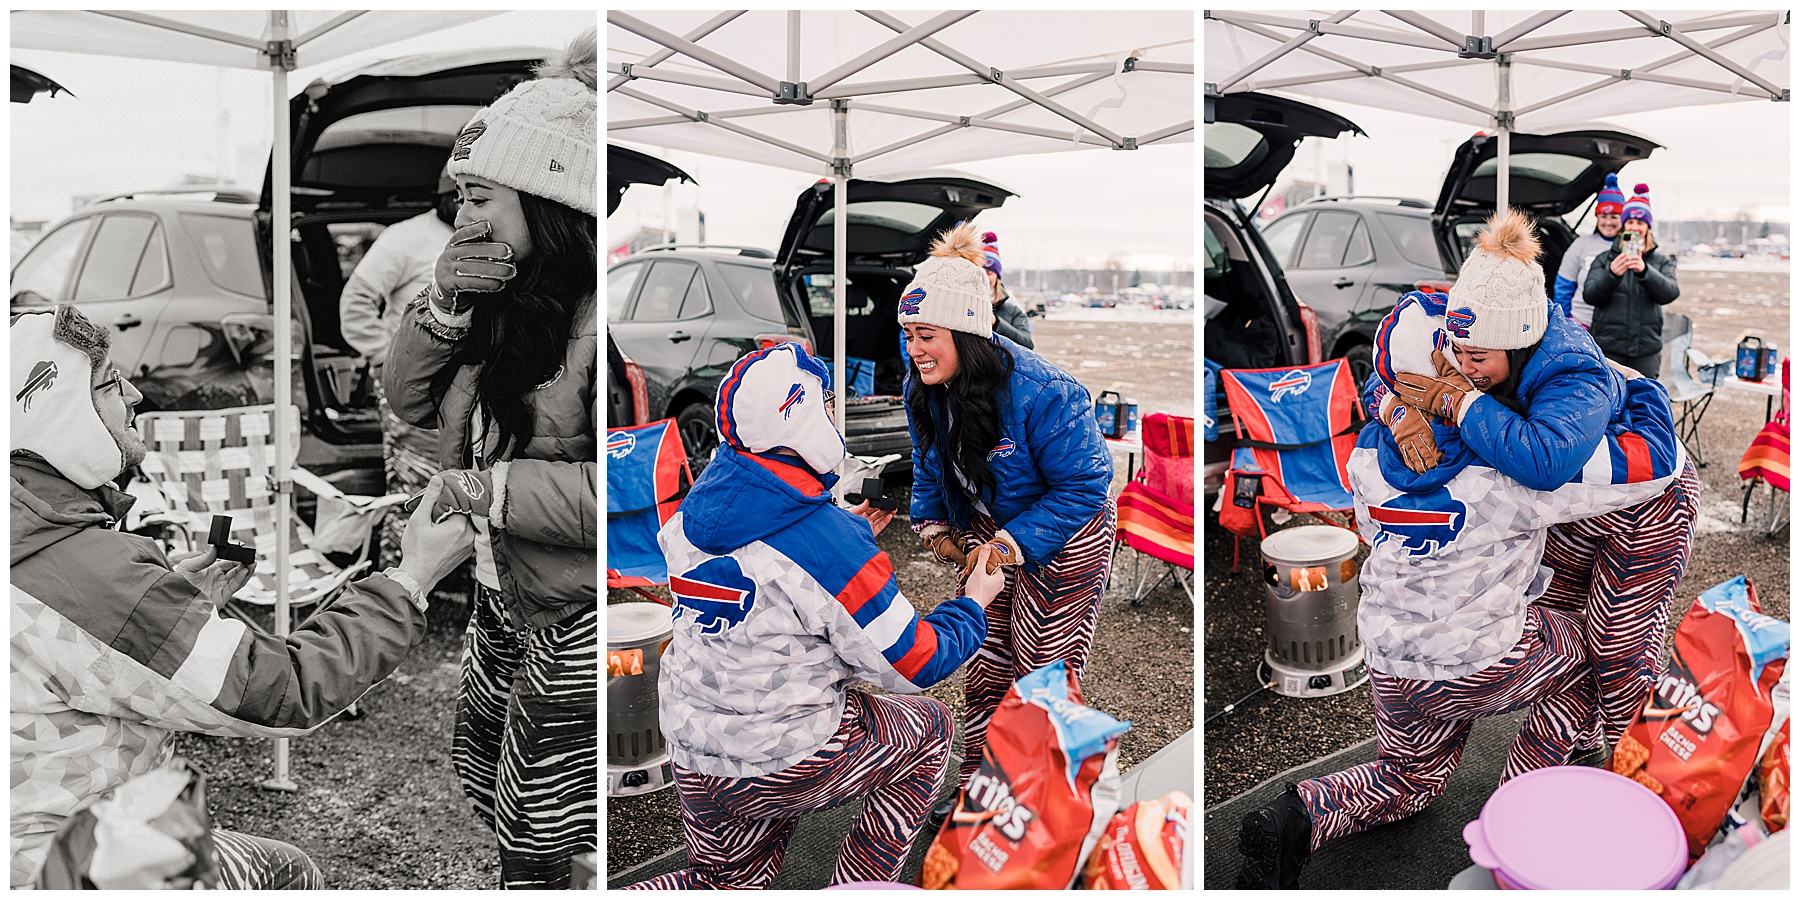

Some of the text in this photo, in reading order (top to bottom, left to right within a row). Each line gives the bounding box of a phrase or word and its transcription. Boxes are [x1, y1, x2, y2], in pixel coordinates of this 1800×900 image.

[1660, 731, 1692, 762] CHEESE
[1666, 726, 1697, 753] NACHO
[1116, 842, 1150, 890] ORIGIN
